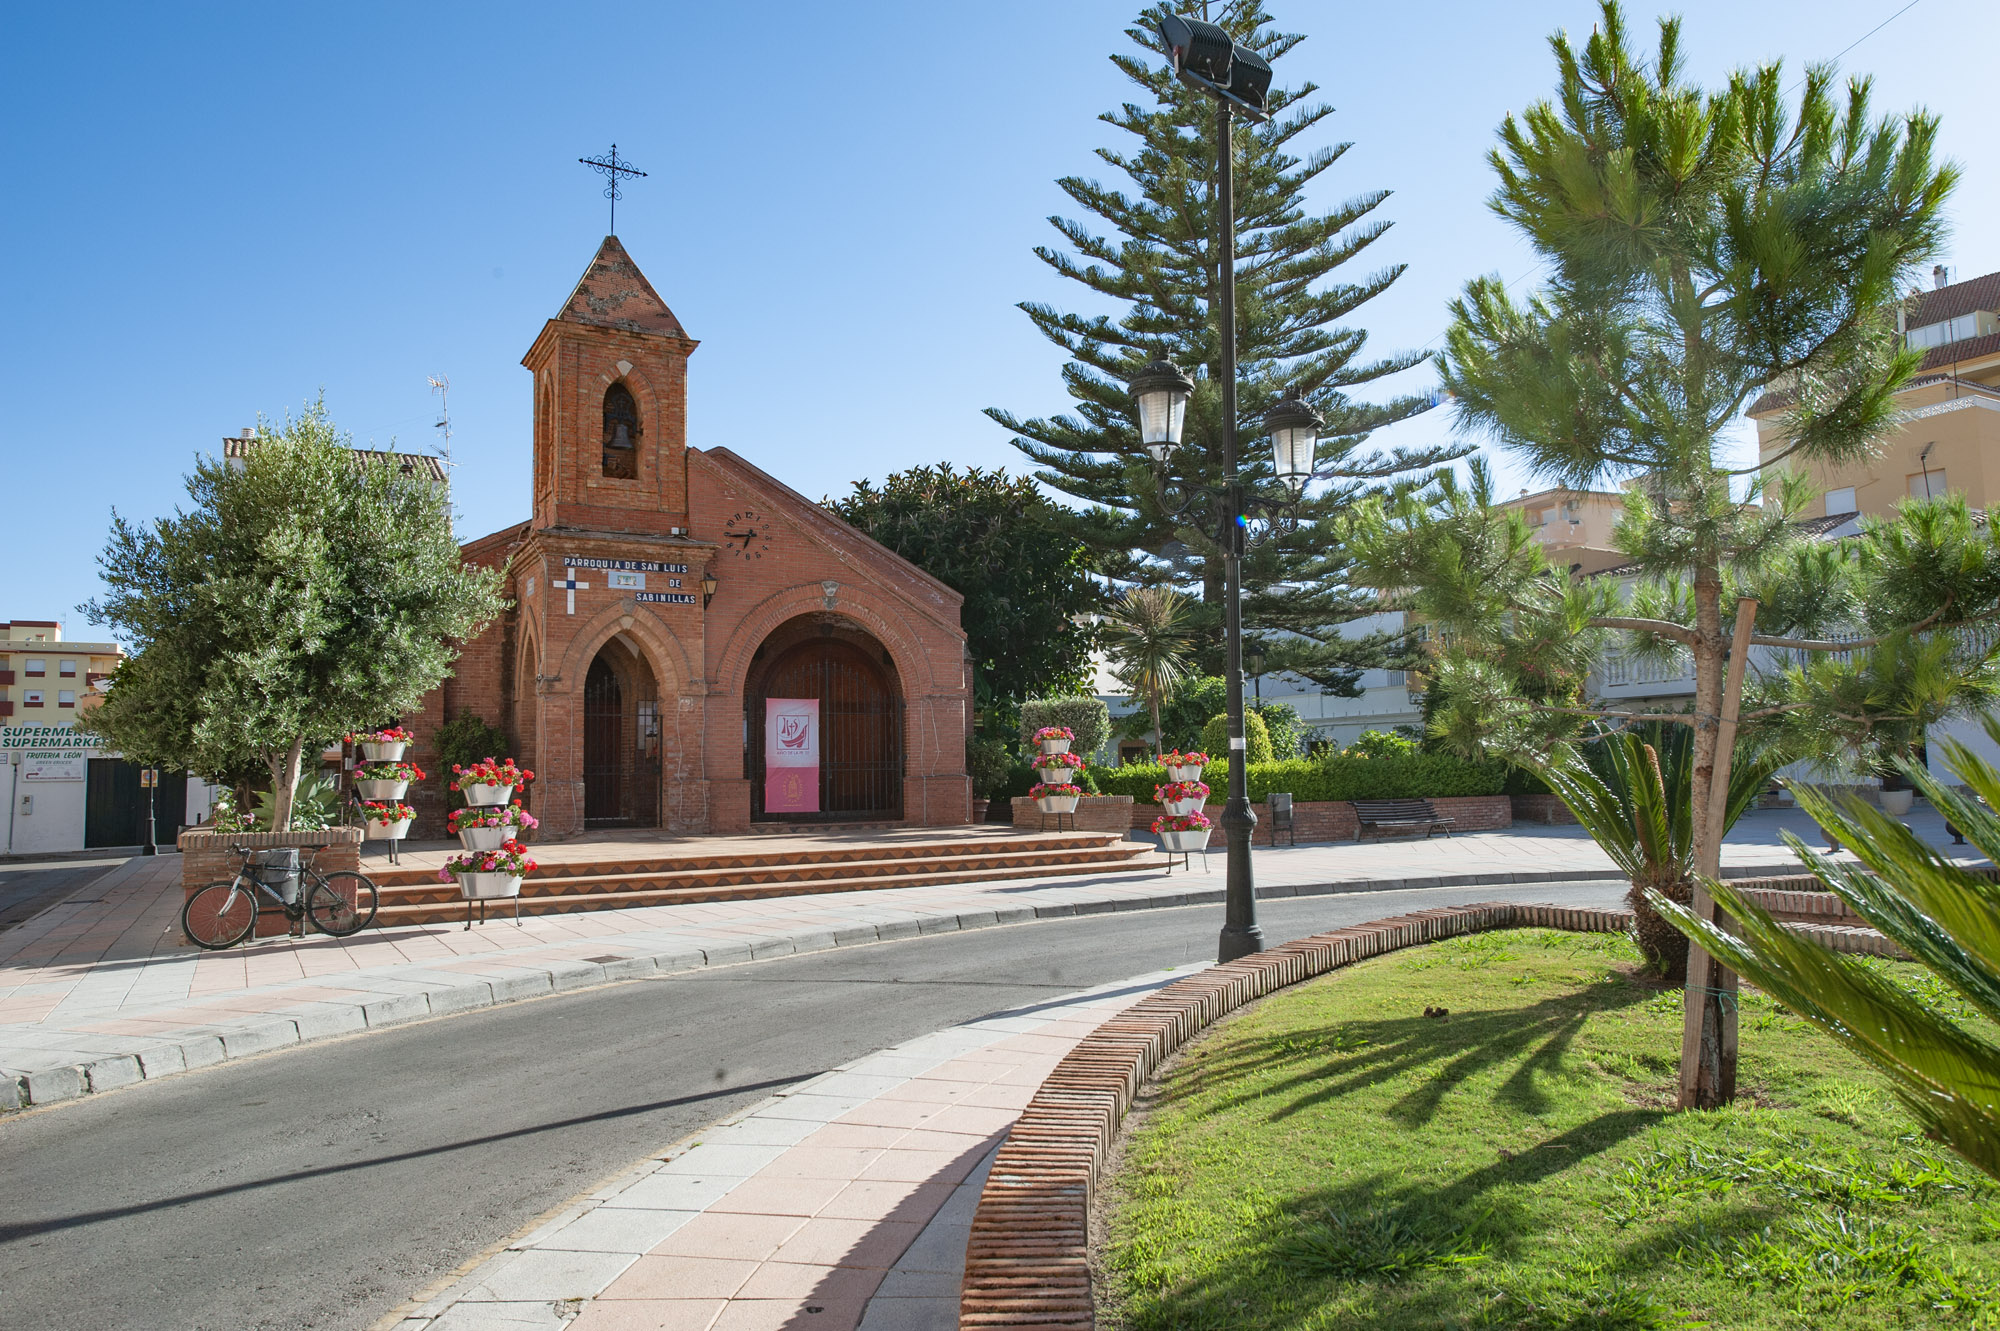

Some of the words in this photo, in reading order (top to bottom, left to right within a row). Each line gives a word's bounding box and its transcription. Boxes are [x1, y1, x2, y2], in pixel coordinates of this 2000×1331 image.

[734, 513, 741, 521] 11
[564, 558, 621, 570] PARROQUIA
[624, 561, 637, 570] DE
[641, 562, 659, 572] SAN
[664, 564, 688, 573] LUIS
[669, 579, 681, 588] DE
[636, 593, 696, 604] SABINILLAS
[63, 751, 82, 759] LEÓN
